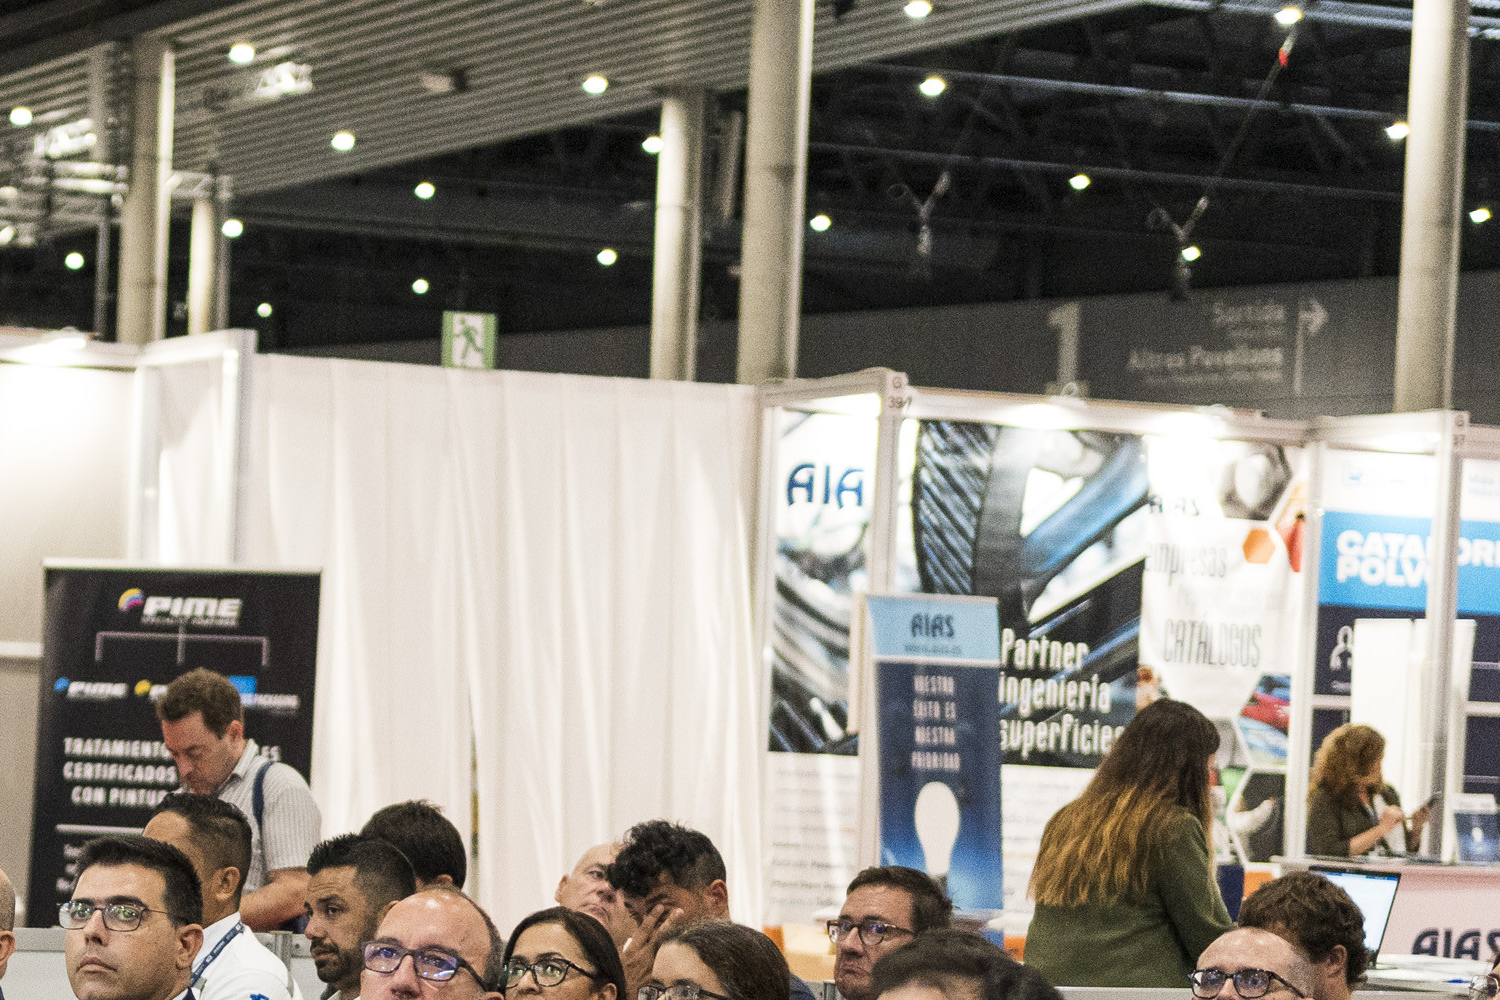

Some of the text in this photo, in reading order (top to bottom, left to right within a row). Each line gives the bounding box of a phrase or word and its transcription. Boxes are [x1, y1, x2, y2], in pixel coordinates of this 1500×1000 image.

[787, 463, 864, 510] AIA
[1336, 553, 1430, 588] POLV
[143, 596, 242, 617] PIME
[911, 612, 955, 638] AIAS
[1001, 628, 1090, 670] Partner
[63, 737, 172, 760] TRATAMIENTO
[63, 761, 178, 784] CERTIFICADOS
[71, 786, 168, 807] CON PINTUR
